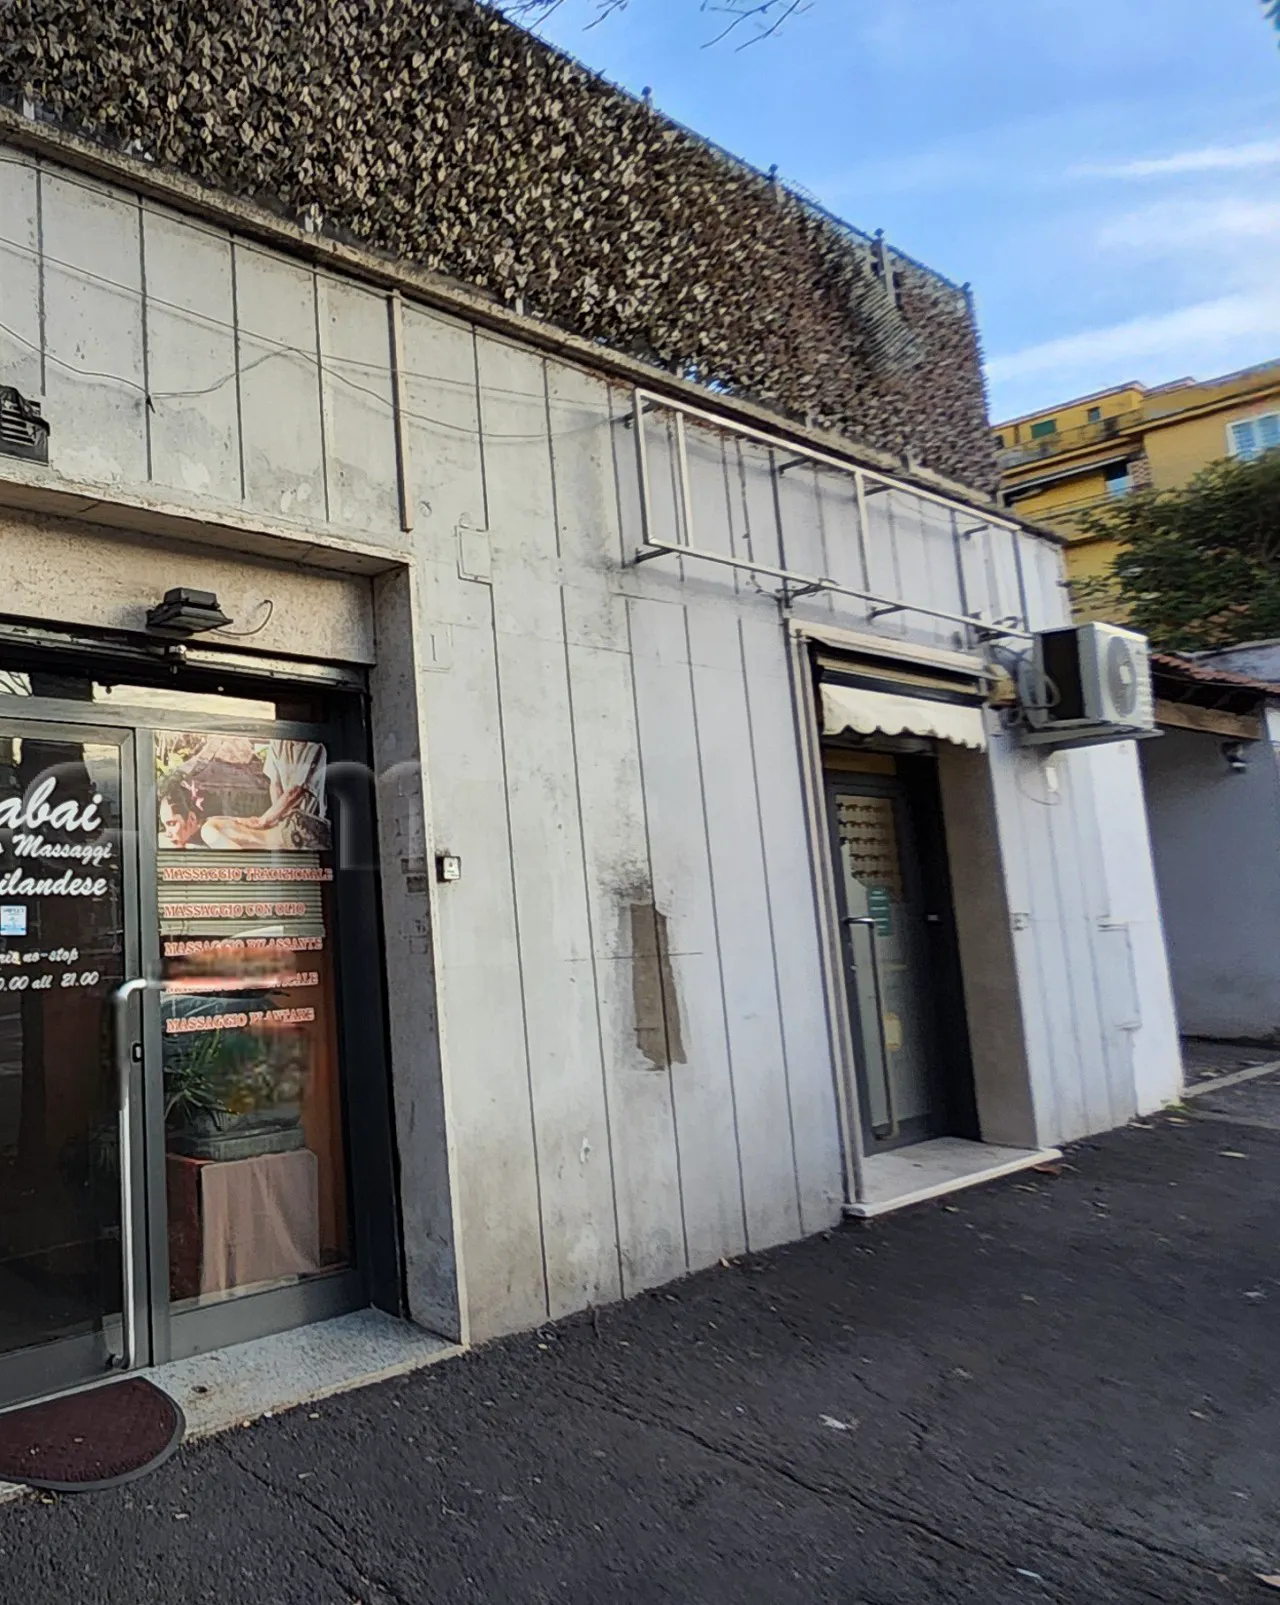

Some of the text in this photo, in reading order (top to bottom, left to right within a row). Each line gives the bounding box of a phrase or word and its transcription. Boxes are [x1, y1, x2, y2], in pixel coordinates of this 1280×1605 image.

[12, 834, 113, 867] Massaggi
[163, 867, 242, 881] MASSAGGIO
[164, 902, 306, 919] MASSAGGIO CON OLIO
[23, 946, 79, 965] no-stop
[61, 971, 100, 987] 21.00
[166, 1014, 248, 1034] MASSAGGIO
